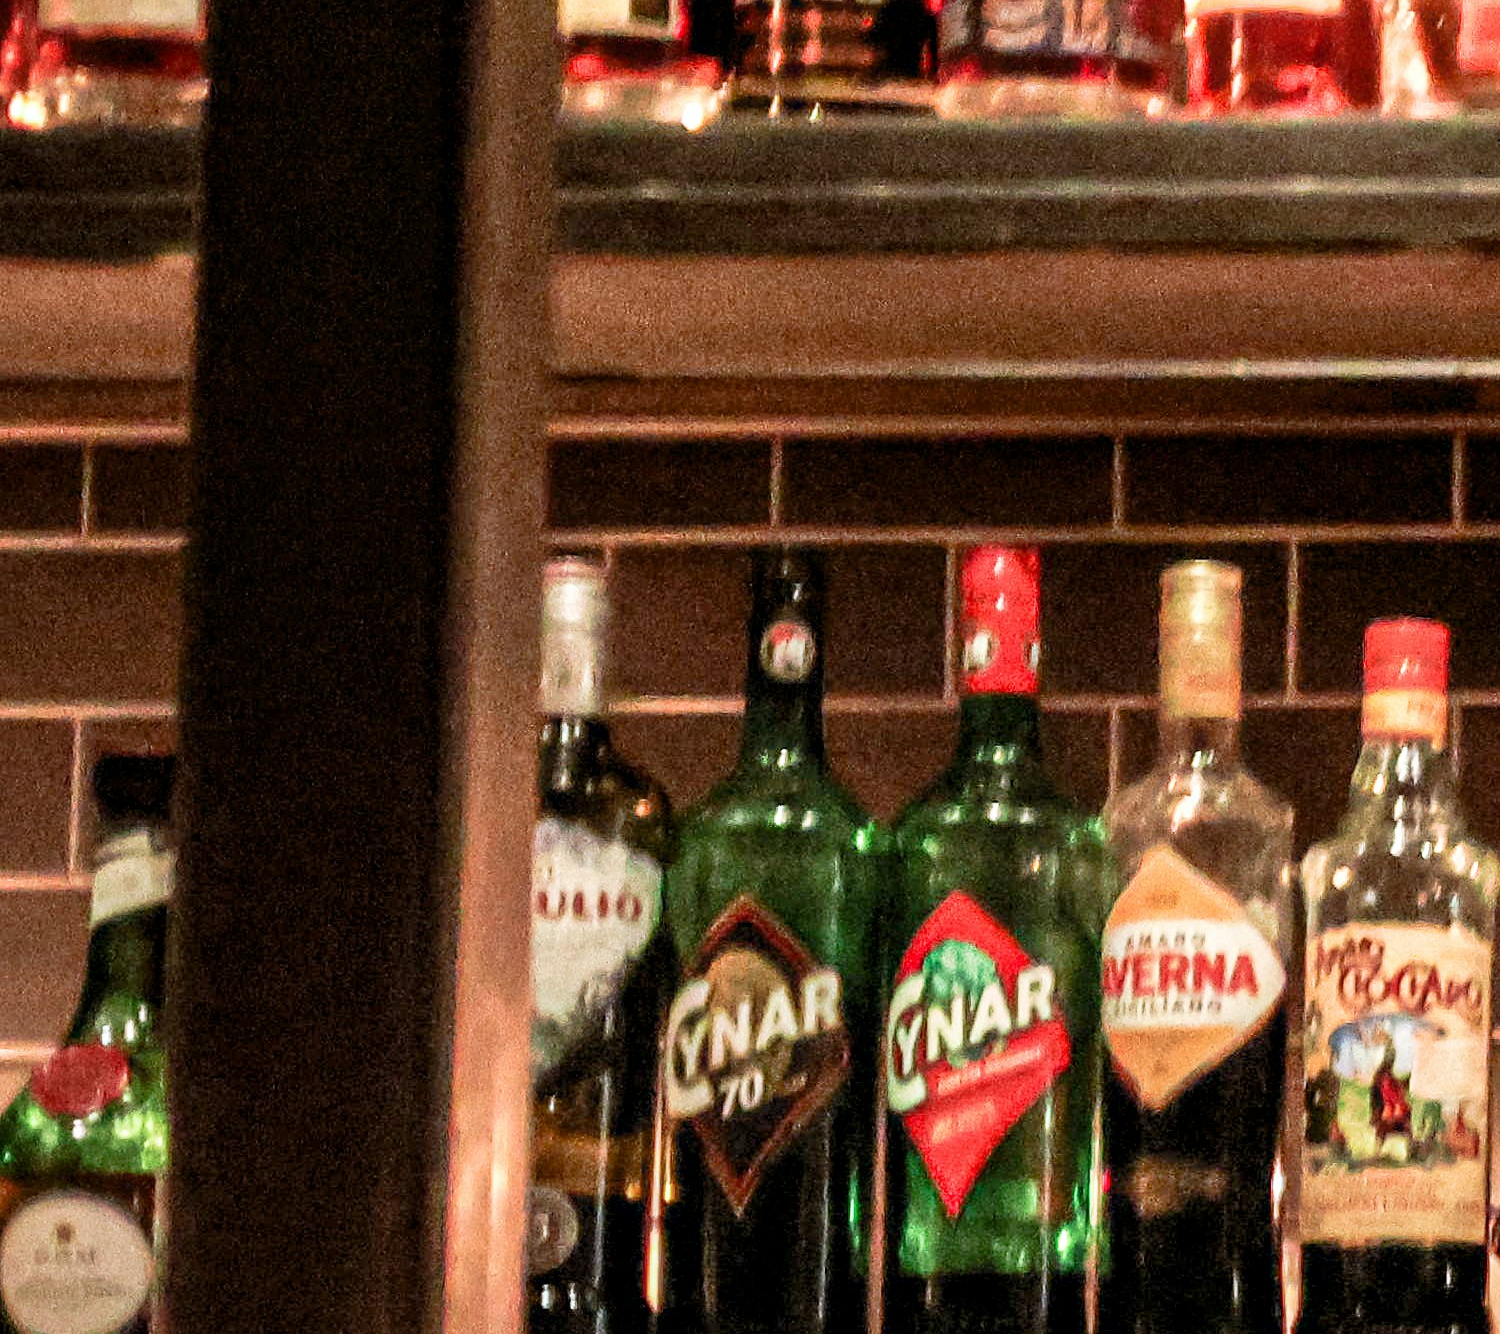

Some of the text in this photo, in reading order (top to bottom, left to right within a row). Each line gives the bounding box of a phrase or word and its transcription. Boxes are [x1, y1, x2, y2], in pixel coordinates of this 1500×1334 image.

[664, 967, 842, 1119] CYNAR
[720, 1071, 766, 1120] 70
[886, 964, 1056, 1113] CYNAR
